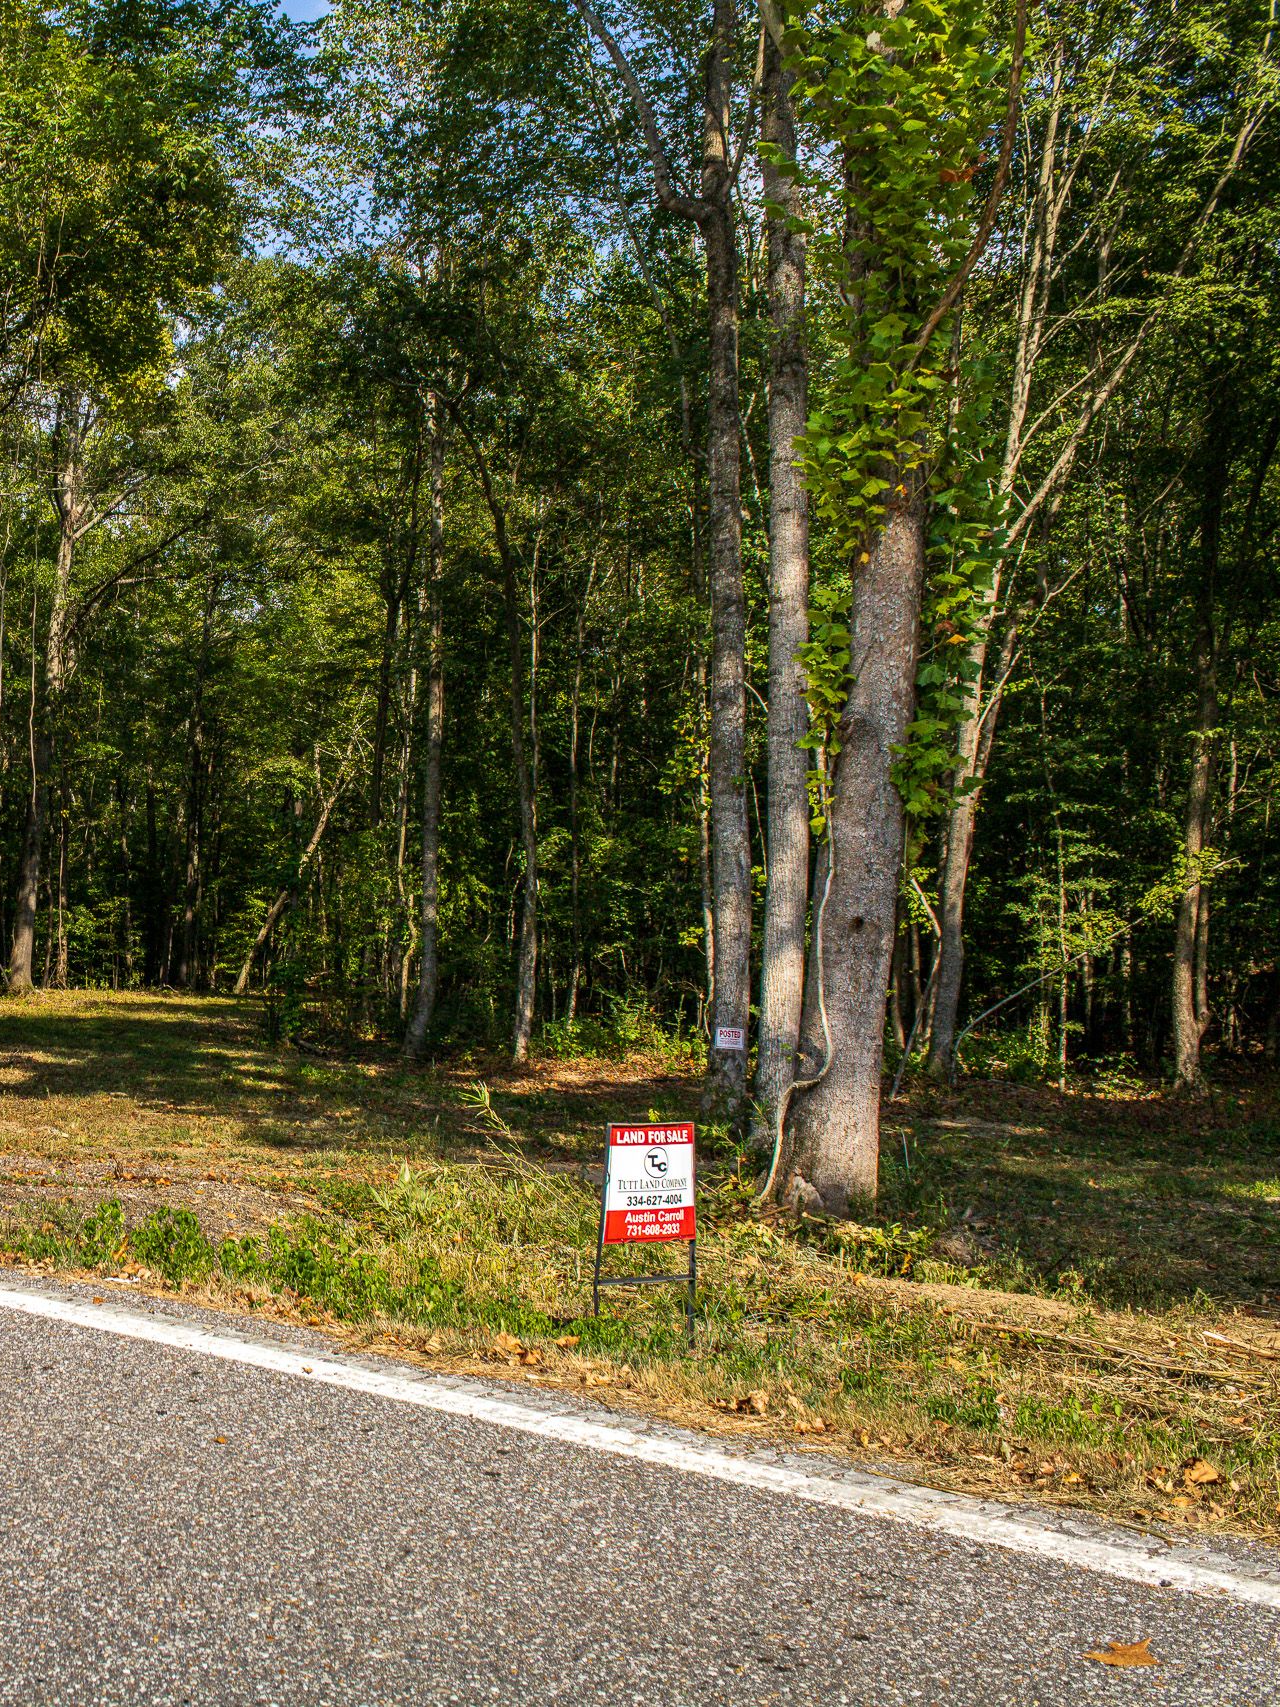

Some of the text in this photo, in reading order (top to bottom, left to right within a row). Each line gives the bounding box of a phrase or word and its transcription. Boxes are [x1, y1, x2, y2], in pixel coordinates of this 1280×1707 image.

[719, 1029, 741, 1038] POSTED
[616, 1129, 688, 1144] LAND FOR SALE
[640, 1179, 660, 1189] LAND
[626, 1194, 682, 1206] 334-627-4004
[624, 1209, 685, 1223] Austin Carroll
[626, 1223, 680, 1236] 731-608-2933
